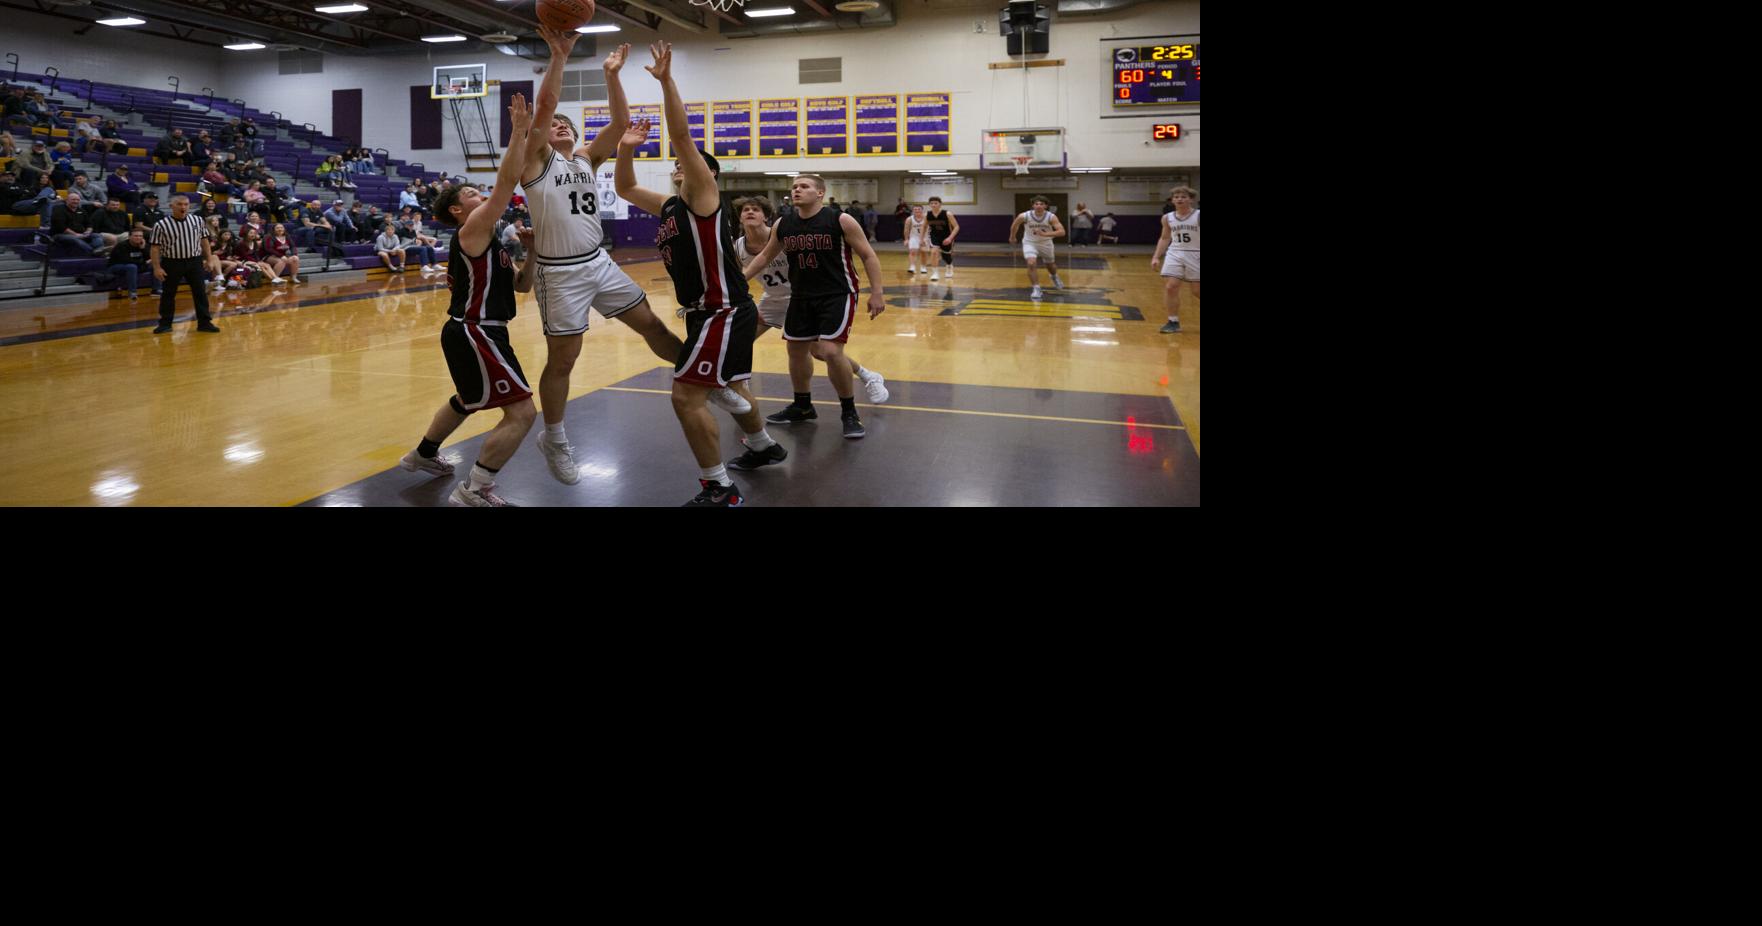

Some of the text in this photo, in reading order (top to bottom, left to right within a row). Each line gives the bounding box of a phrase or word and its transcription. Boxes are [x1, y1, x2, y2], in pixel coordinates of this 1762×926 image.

[1152, 45, 1193, 60] 2:25
[1120, 69, 1144, 83] 60
[1161, 70, 1172, 79] 4
[1120, 88, 1130, 98] 0
[1155, 125, 1177, 139] 29
[554, 172, 595, 187] WARRI
[568, 191, 596, 215] 13
[784, 234, 832, 253] OCOSTA
[1177, 232, 1191, 243] 15
[798, 253, 818, 269] 14
[763, 270, 788, 287] 21
[697, 360, 713, 376] O
[495, 379, 511, 394] O
